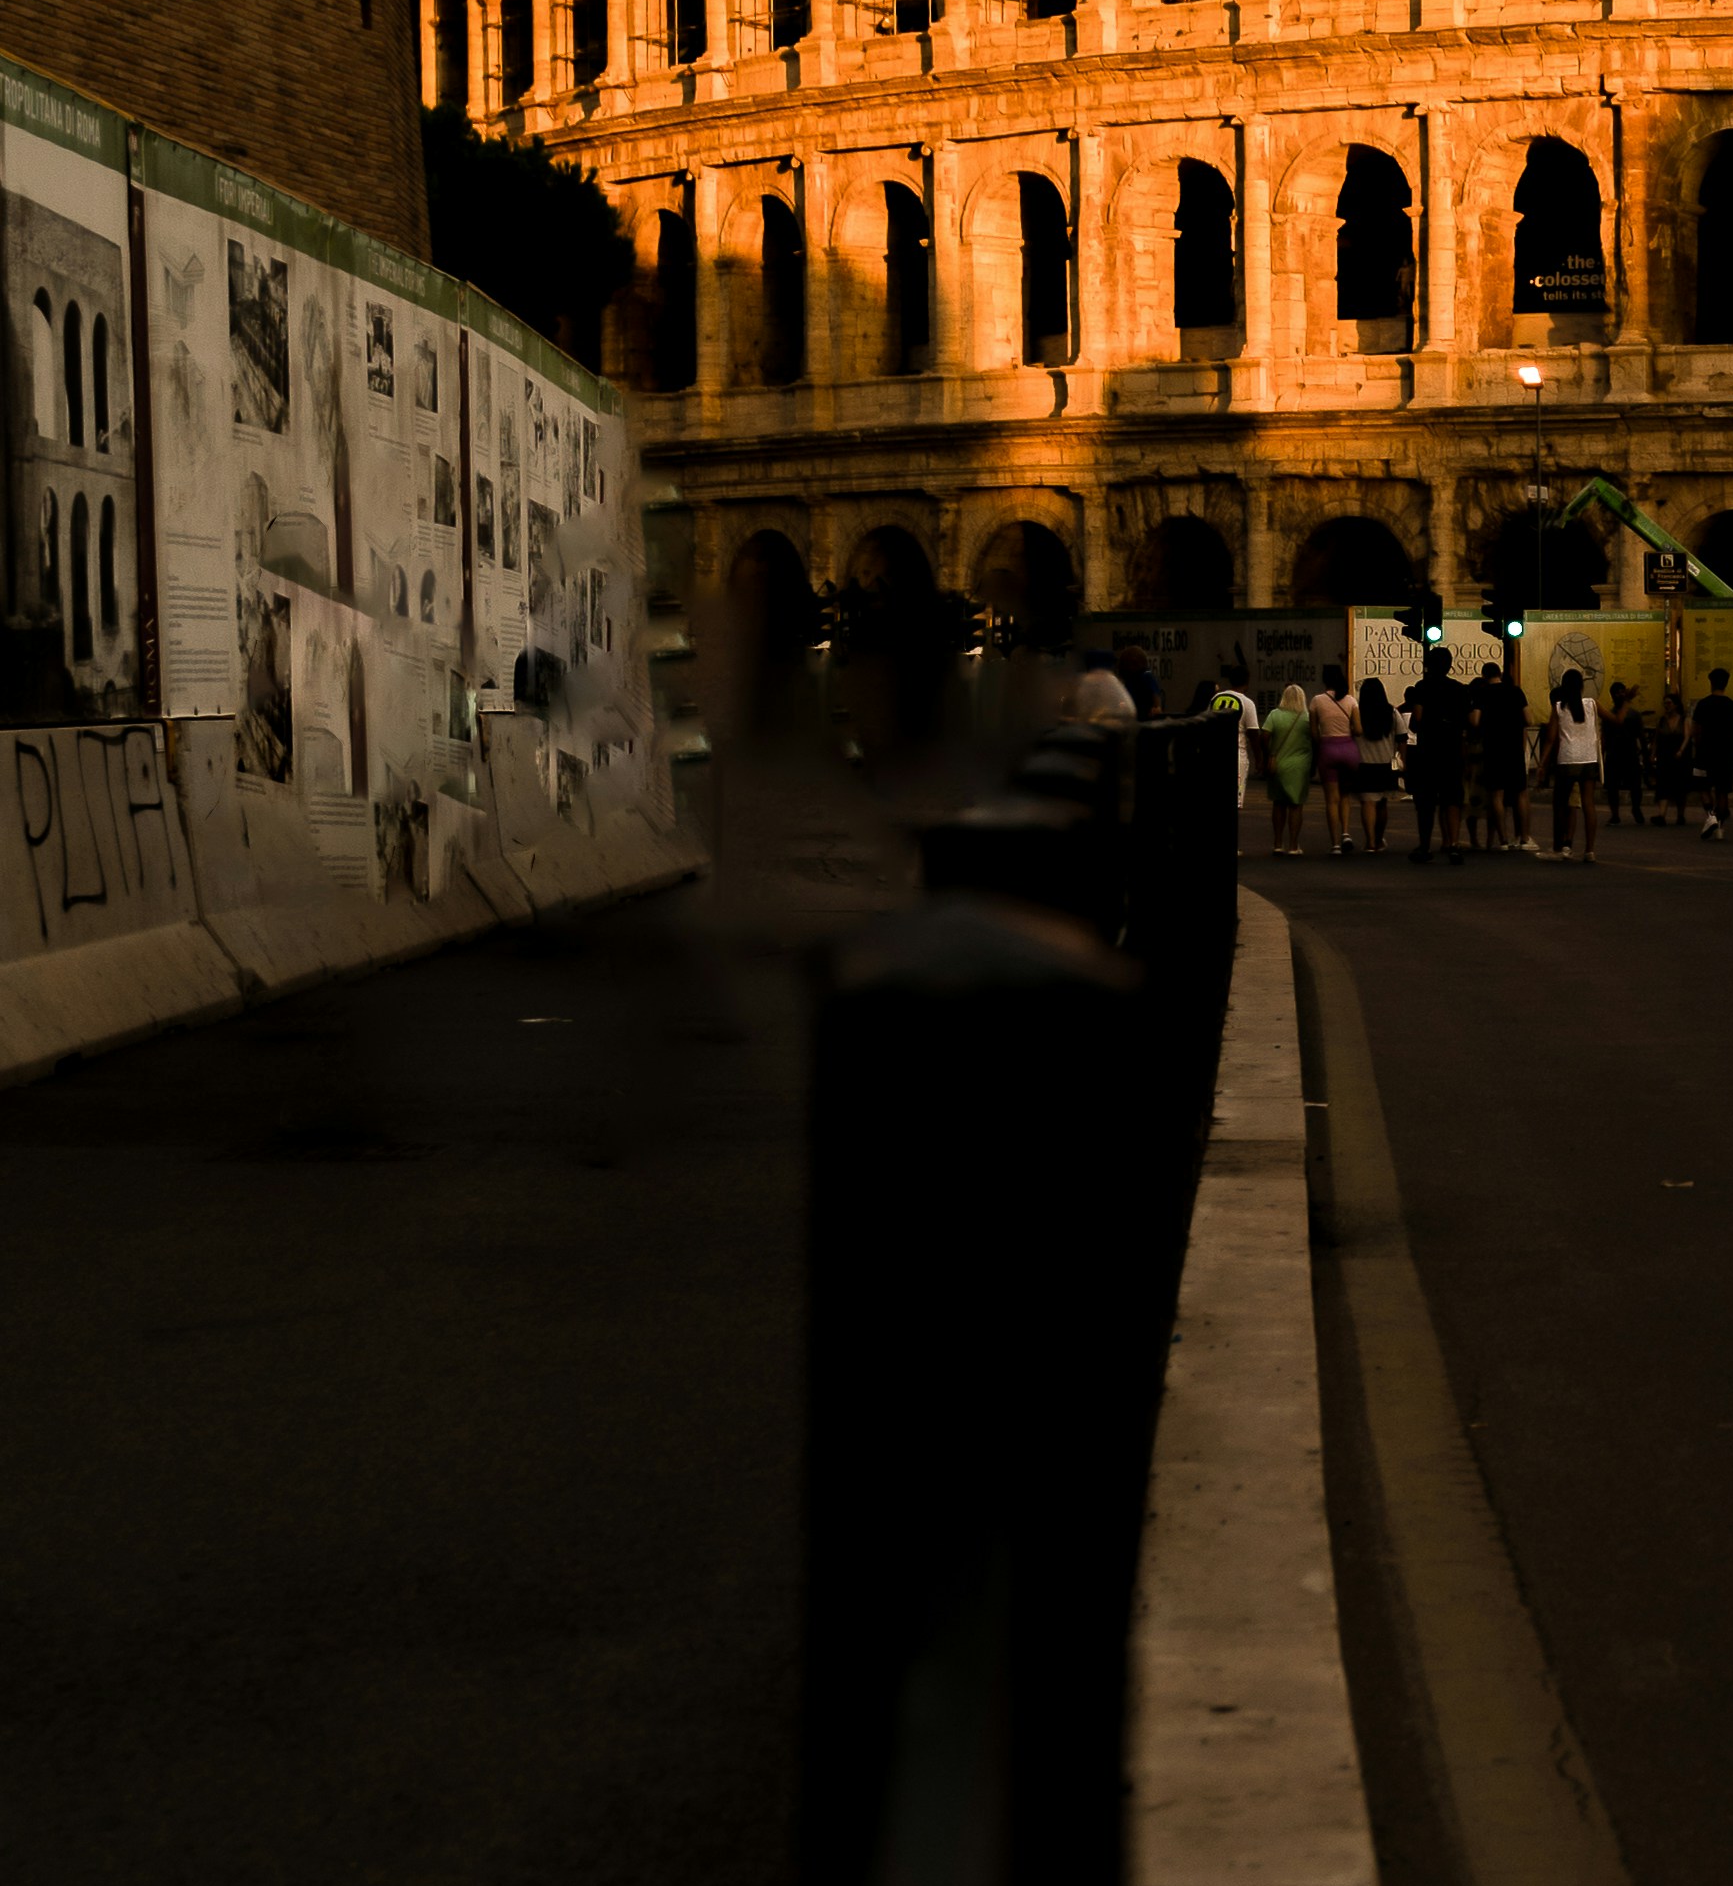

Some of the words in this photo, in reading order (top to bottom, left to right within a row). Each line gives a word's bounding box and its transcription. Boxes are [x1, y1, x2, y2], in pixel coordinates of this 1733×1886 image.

[65, 103, 75, 135] DI
[76, 109, 101, 148] ROMA
[1567, 255, 1596, 270] the
[1543, 289, 1569, 302] tells
[1572, 290, 1588, 302] its
[1161, 630, 1188, 652] 16.00
[1256, 629, 1313, 656] Biglietterie
[1256, 659, 1285, 682] Ticket
[1287, 659, 1316, 682] Office
[1364, 660, 1396, 676] DEL
